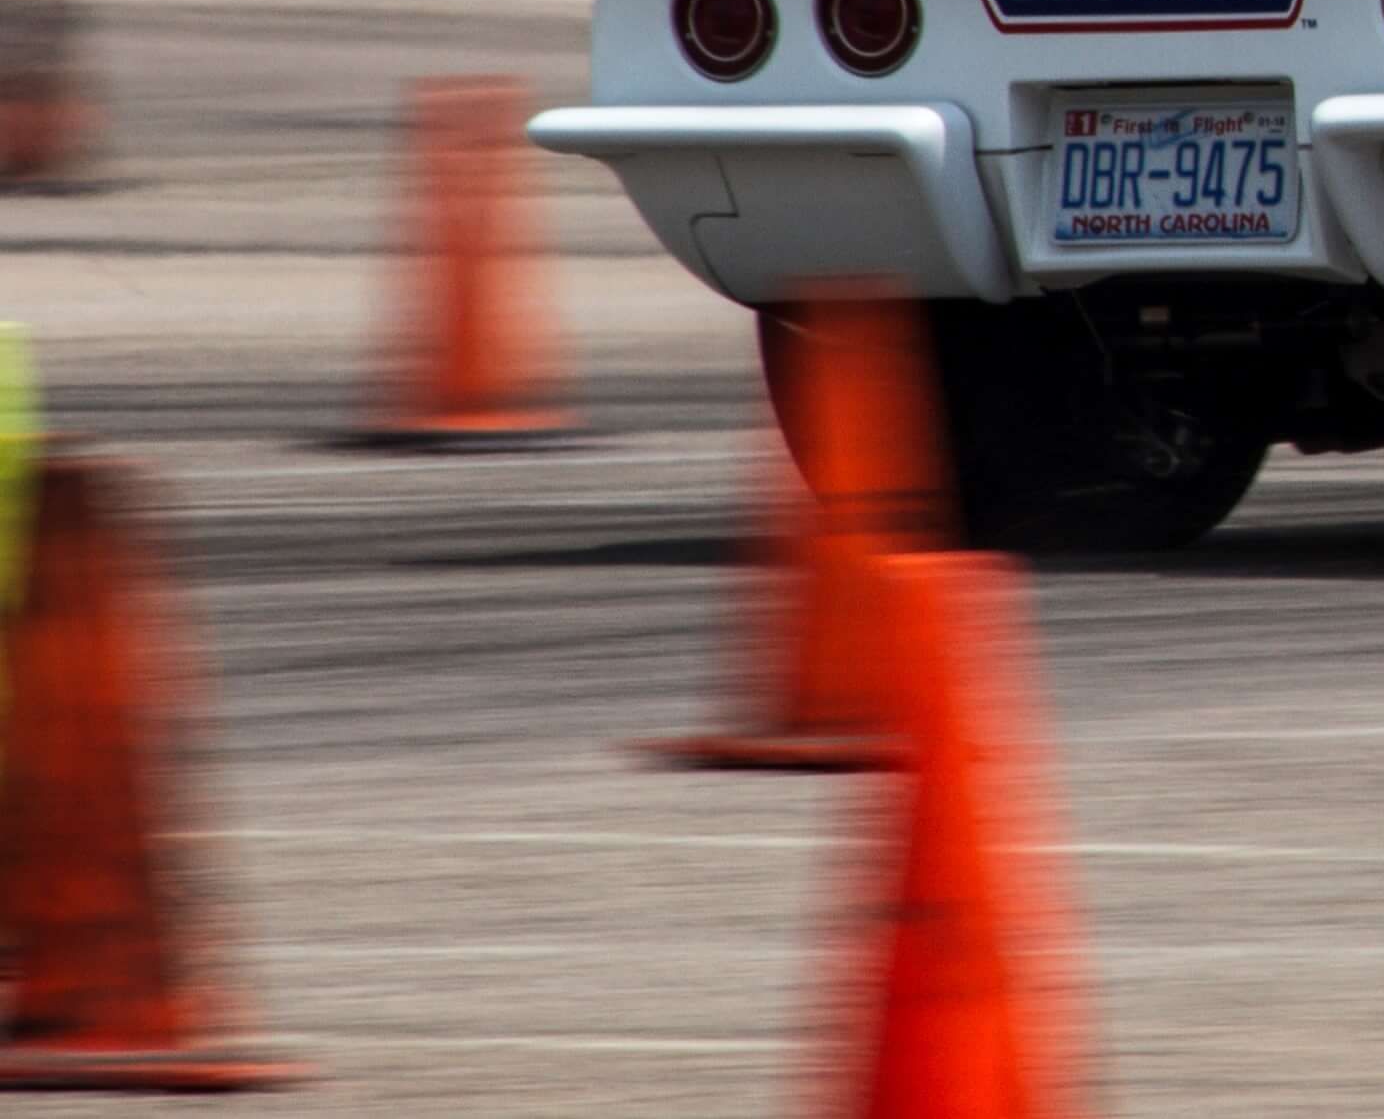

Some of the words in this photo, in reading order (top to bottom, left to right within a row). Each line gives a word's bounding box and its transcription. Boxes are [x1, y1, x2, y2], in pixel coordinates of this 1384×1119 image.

[1112, 118, 1153, 134] First
[1193, 114, 1244, 137] Flight
[1061, 140, 1286, 209] DBR-9475
[1072, 214, 1151, 234] NORTH
[1160, 212, 1271, 234] CAROLINA
